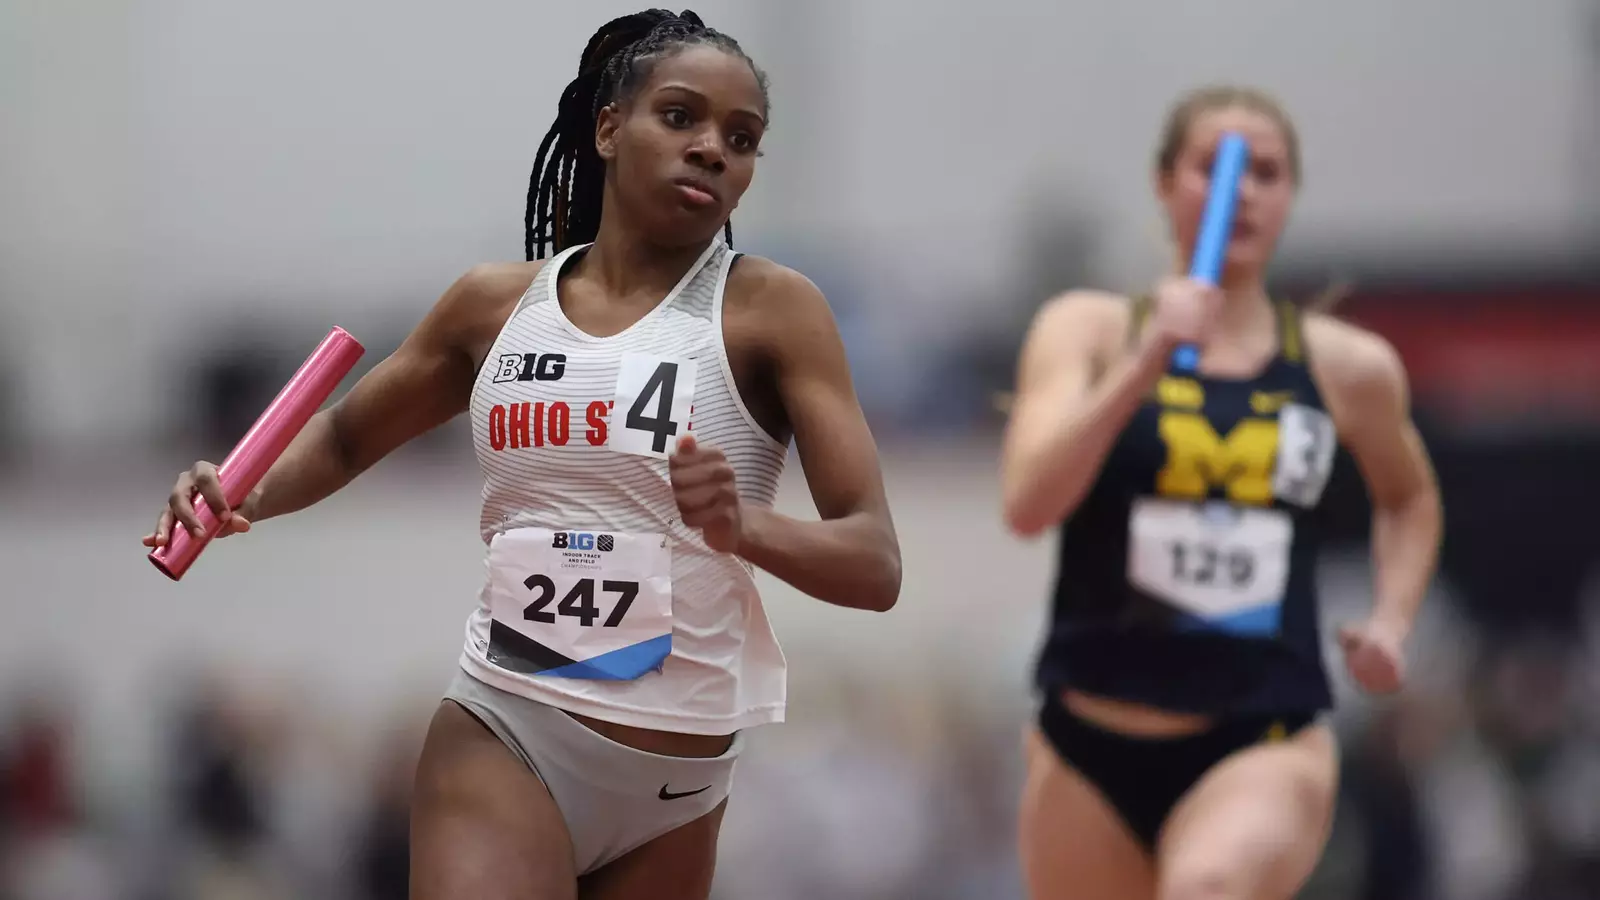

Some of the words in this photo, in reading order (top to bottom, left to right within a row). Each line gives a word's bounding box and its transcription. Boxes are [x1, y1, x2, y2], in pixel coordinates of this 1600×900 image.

[489, 401, 570, 450] OHIO
[625, 361, 678, 453] 4
[1157, 409, 1278, 506] M
[523, 574, 639, 627] 247
